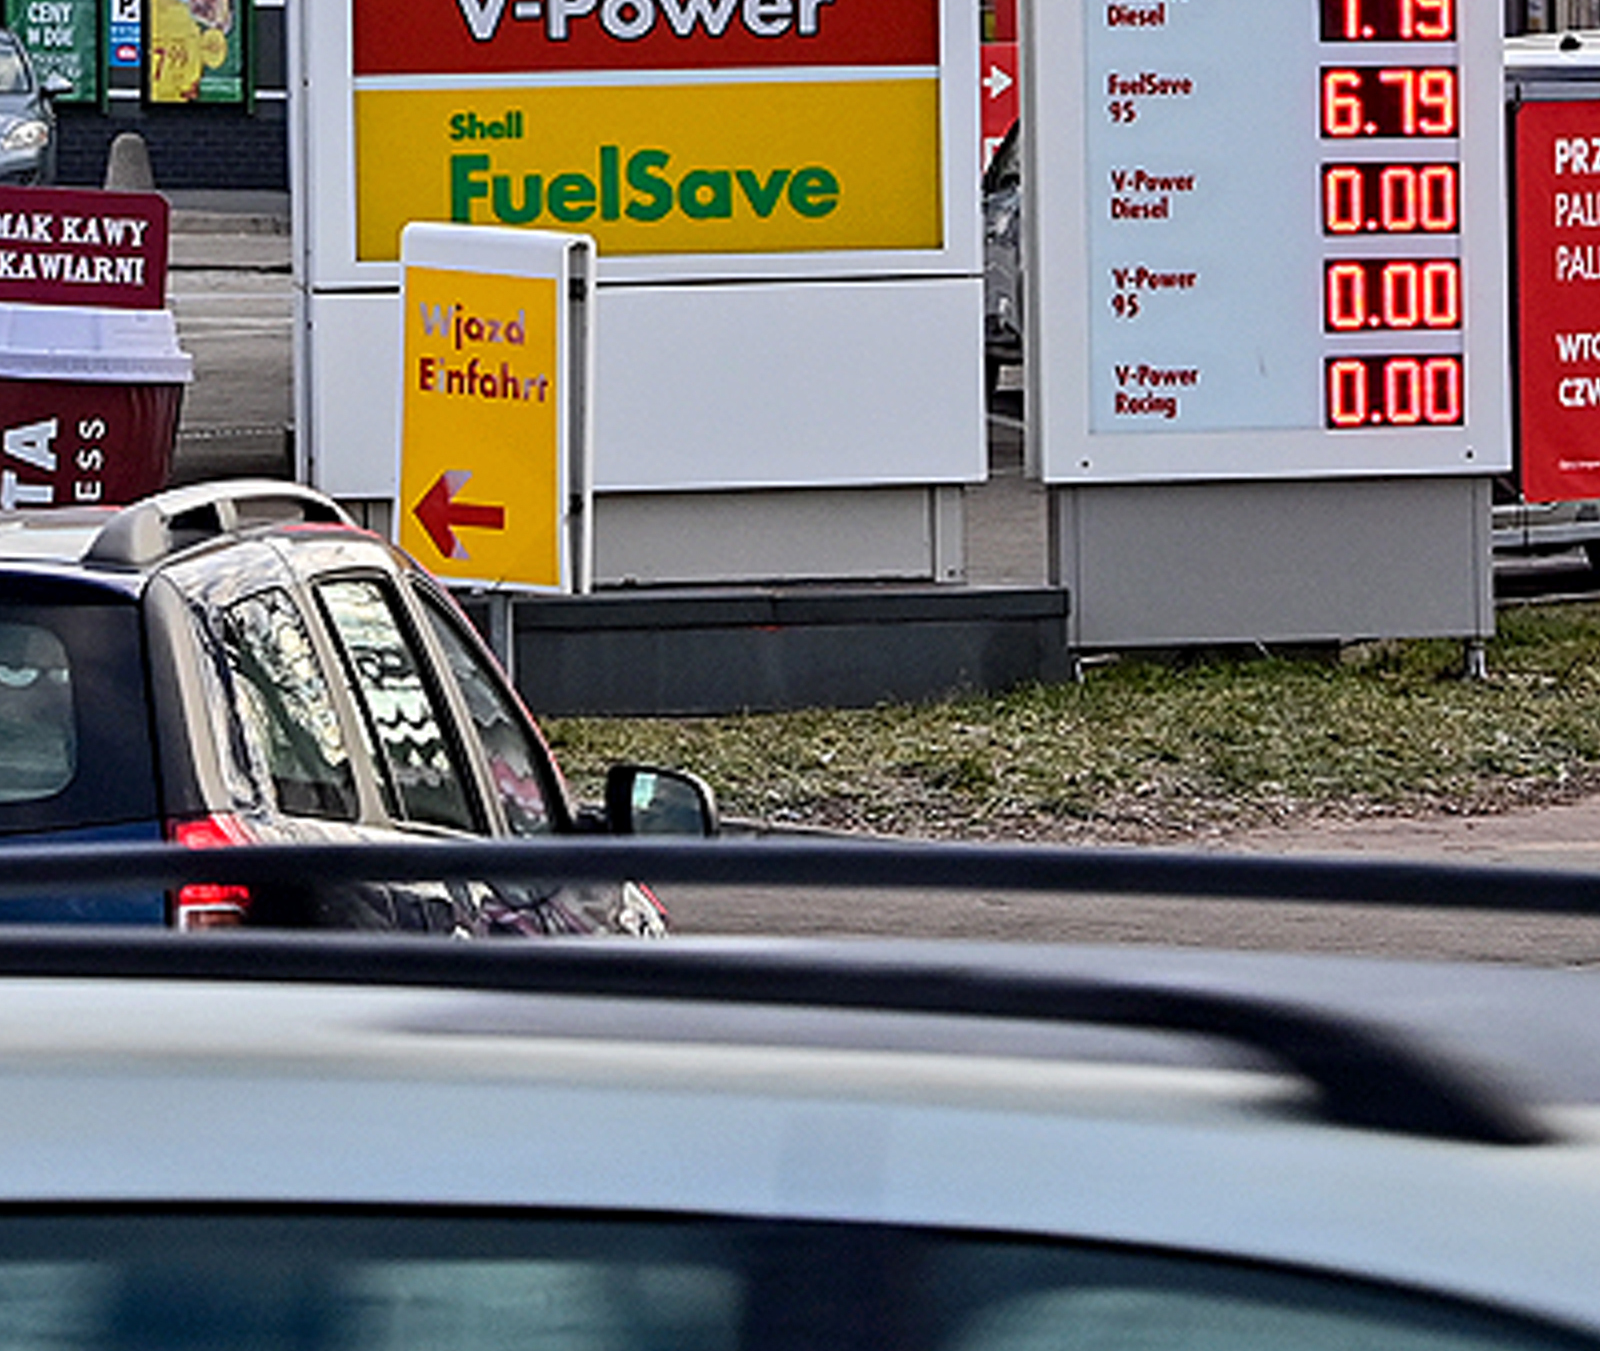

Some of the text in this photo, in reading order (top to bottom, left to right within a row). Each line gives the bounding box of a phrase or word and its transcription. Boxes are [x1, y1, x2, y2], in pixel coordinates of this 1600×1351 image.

[28, 1, 73, 24] CENY
[1108, 3, 1165, 27] Diesel
[1108, 73, 1192, 97] FuelSave
[1108, 101, 1136, 124] 95
[1324, 69, 1453, 135] 6.79
[449, 111, 523, 141] Shell
[450, 147, 840, 224] FuelSave
[1111, 170, 1196, 193] V-Power
[1111, 197, 1169, 221] Diesel
[1326, 167, 1456, 232] 0.00
[60, 216, 148, 247] KAWY
[1111, 268, 1197, 291] V-Power
[1111, 295, 1140, 319] 95
[1328, 261, 1458, 329] 0.00
[419, 302, 526, 349] Wjazd
[419, 355, 549, 404] Einfahrt
[1115, 365, 1199, 388] V-Power
[1115, 392, 1177, 420] Racing
[1330, 359, 1459, 425] 0.00
